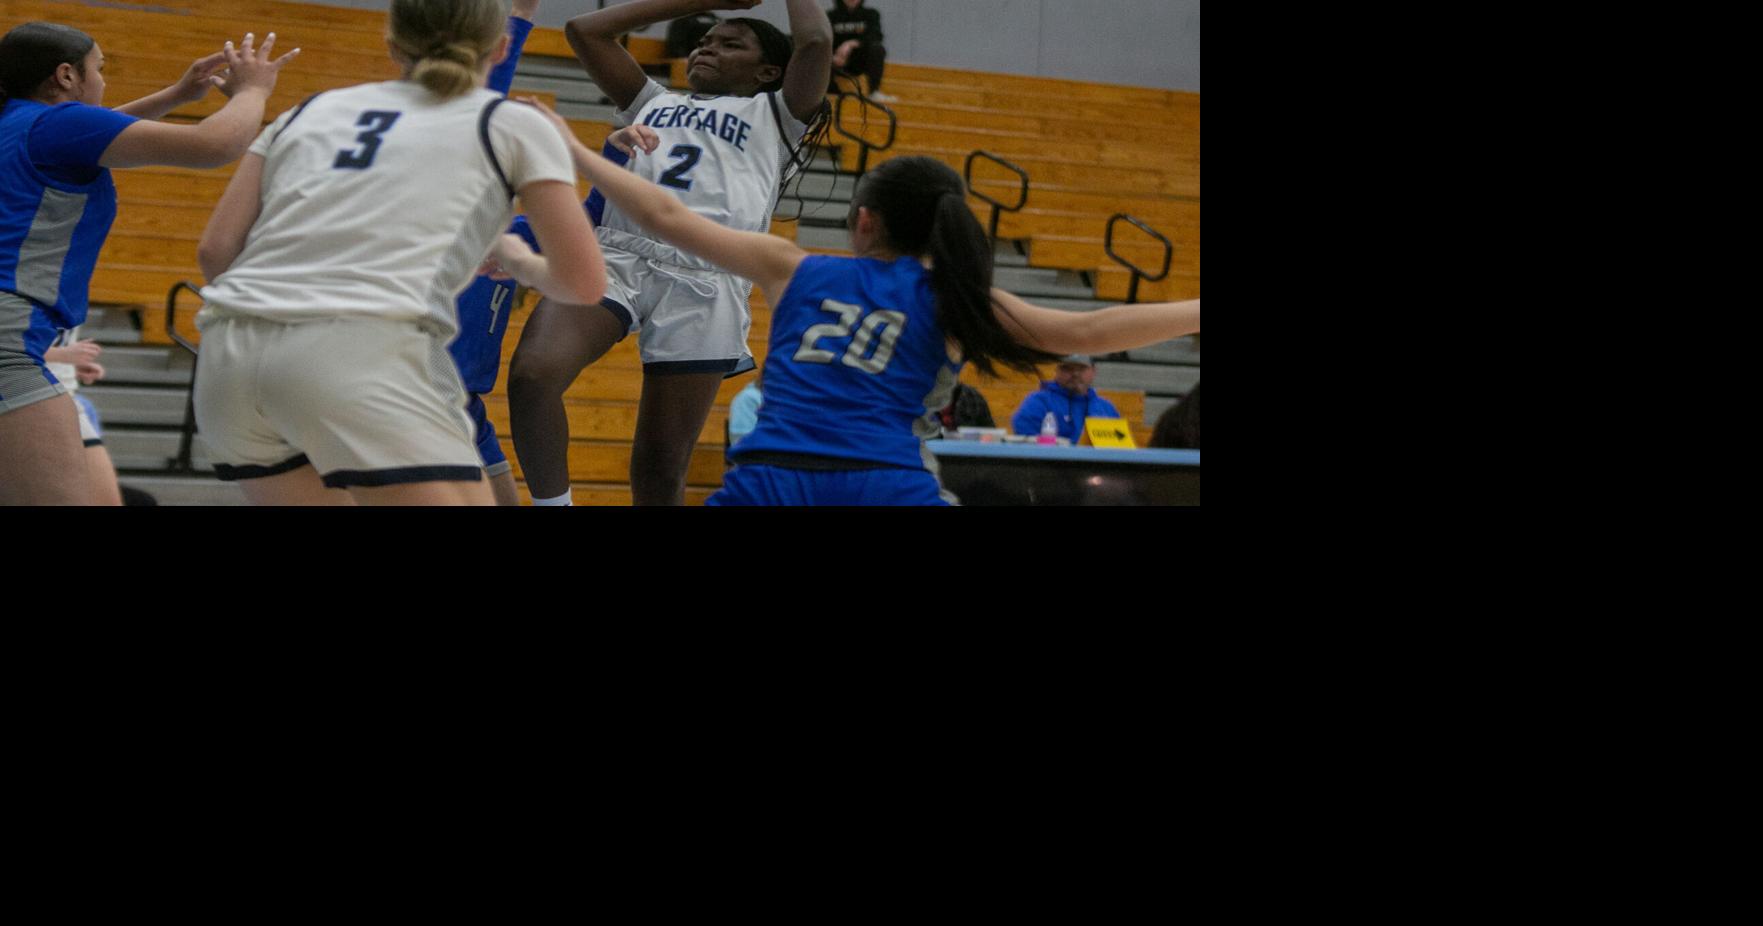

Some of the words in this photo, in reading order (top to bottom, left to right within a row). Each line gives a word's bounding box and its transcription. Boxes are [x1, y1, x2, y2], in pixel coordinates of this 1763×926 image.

[332, 110, 402, 171] 3
[656, 143, 703, 192] 2
[488, 283, 509, 335] 4
[792, 298, 906, 375] 20
